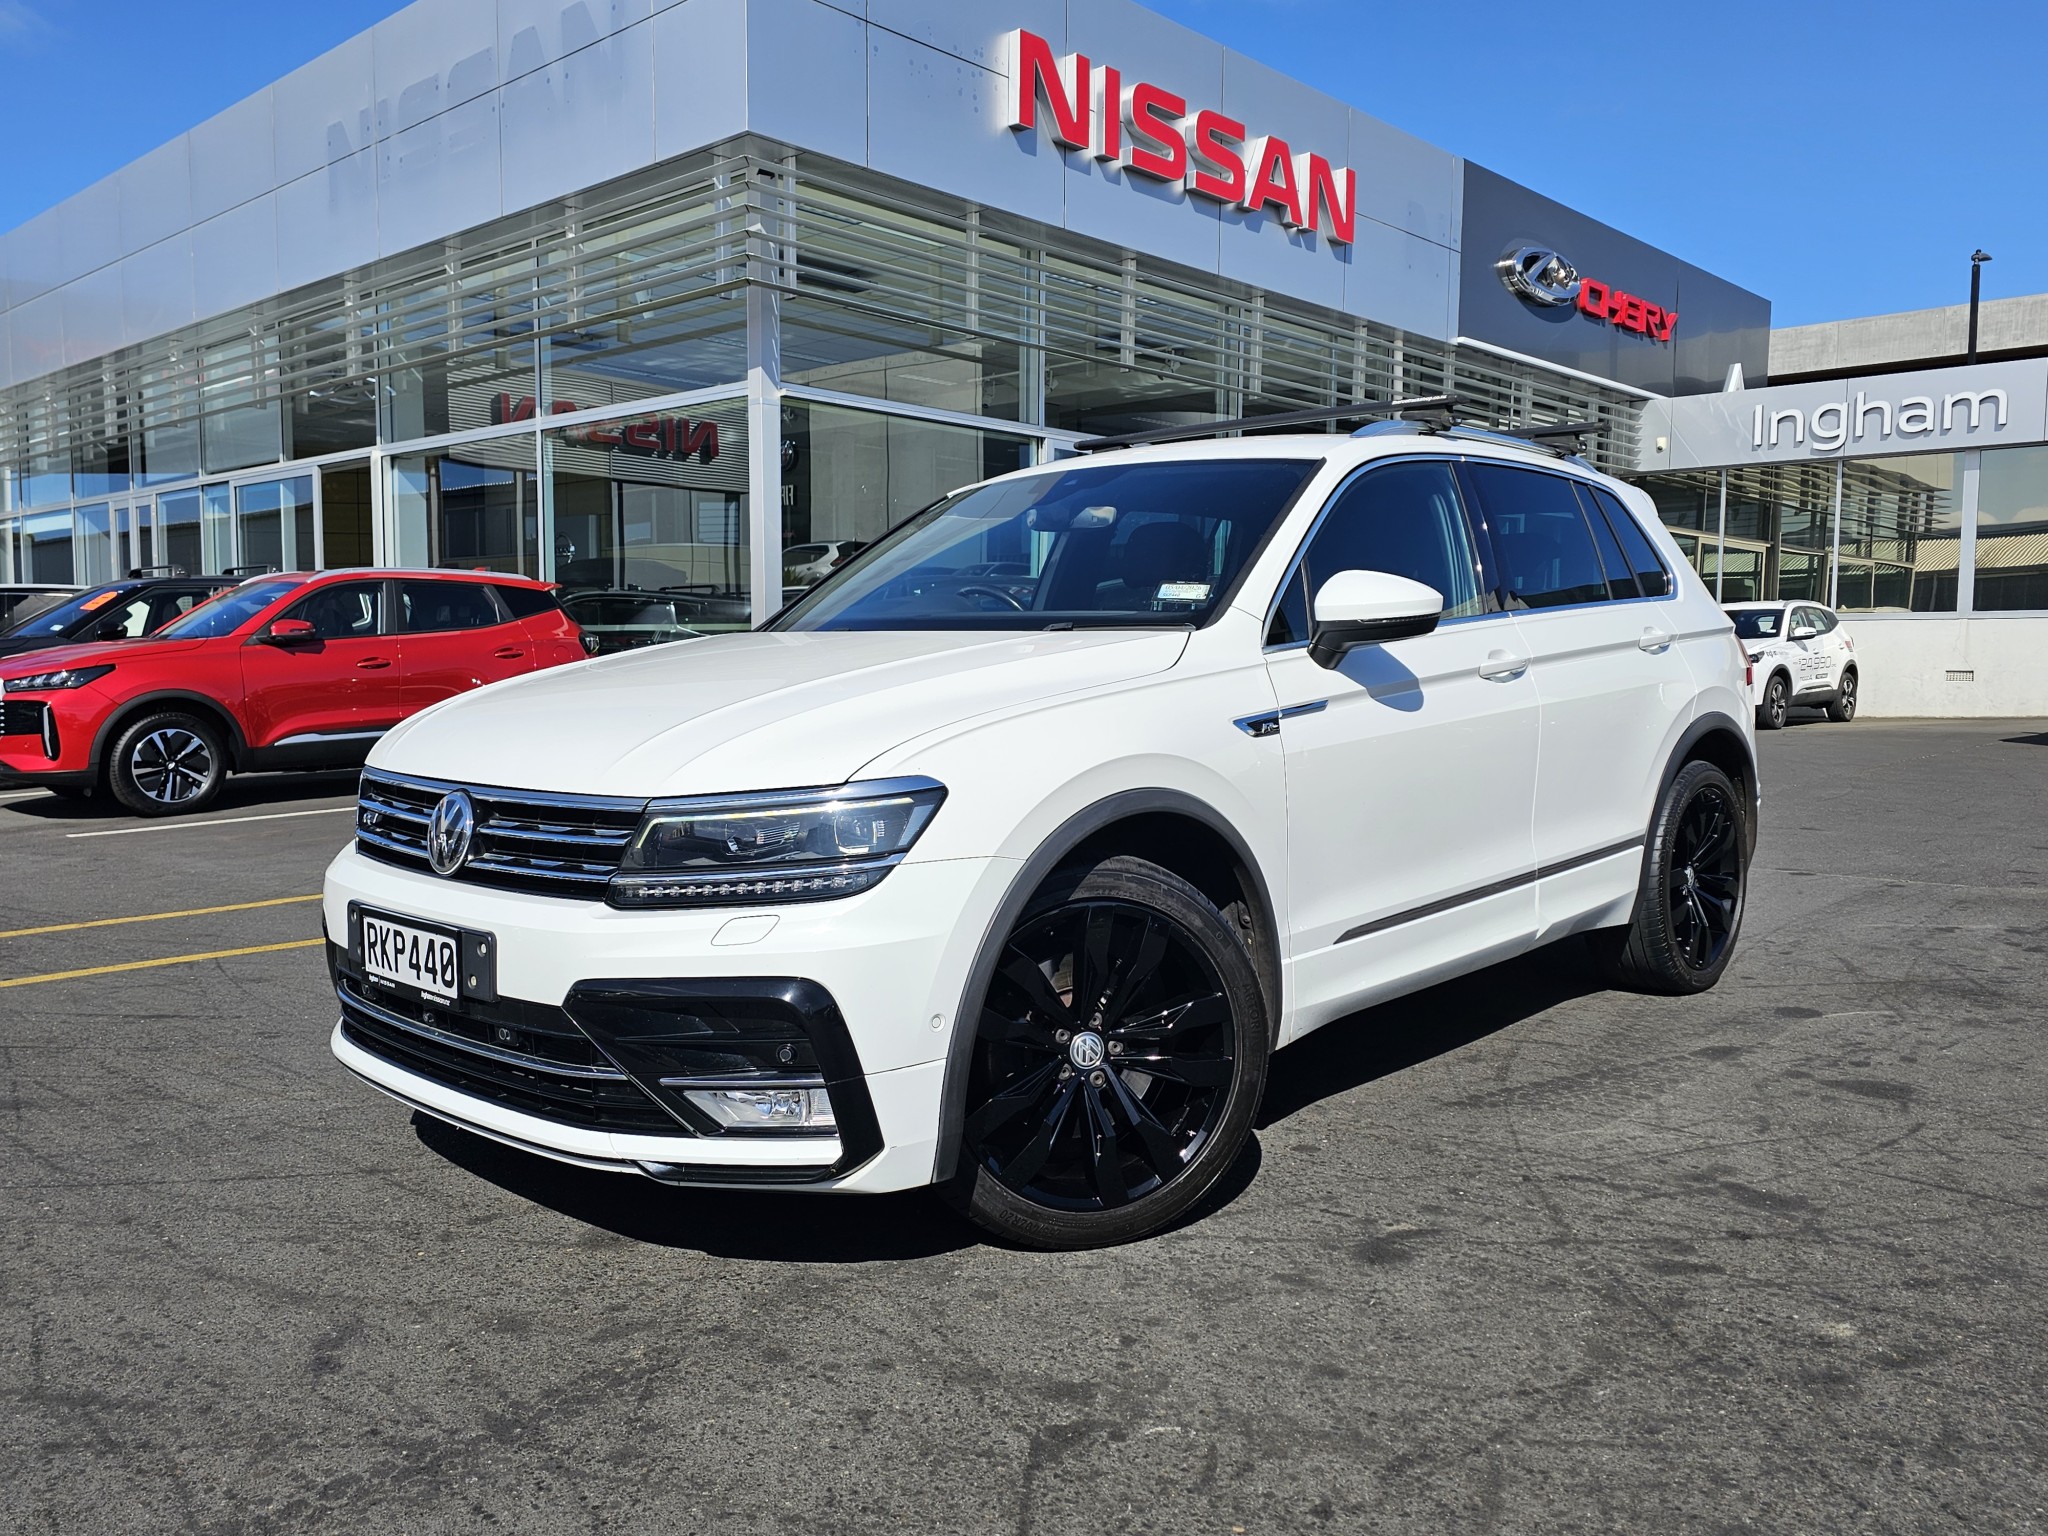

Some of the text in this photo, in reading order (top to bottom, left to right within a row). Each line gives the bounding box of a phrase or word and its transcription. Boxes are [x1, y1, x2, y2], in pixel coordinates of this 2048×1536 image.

[1007, 28, 1356, 246] NISSAN
[1578, 277, 1679, 342] CHERY
[1751, 388, 2009, 452] Ingham
[366, 921, 456, 989] RKP440
